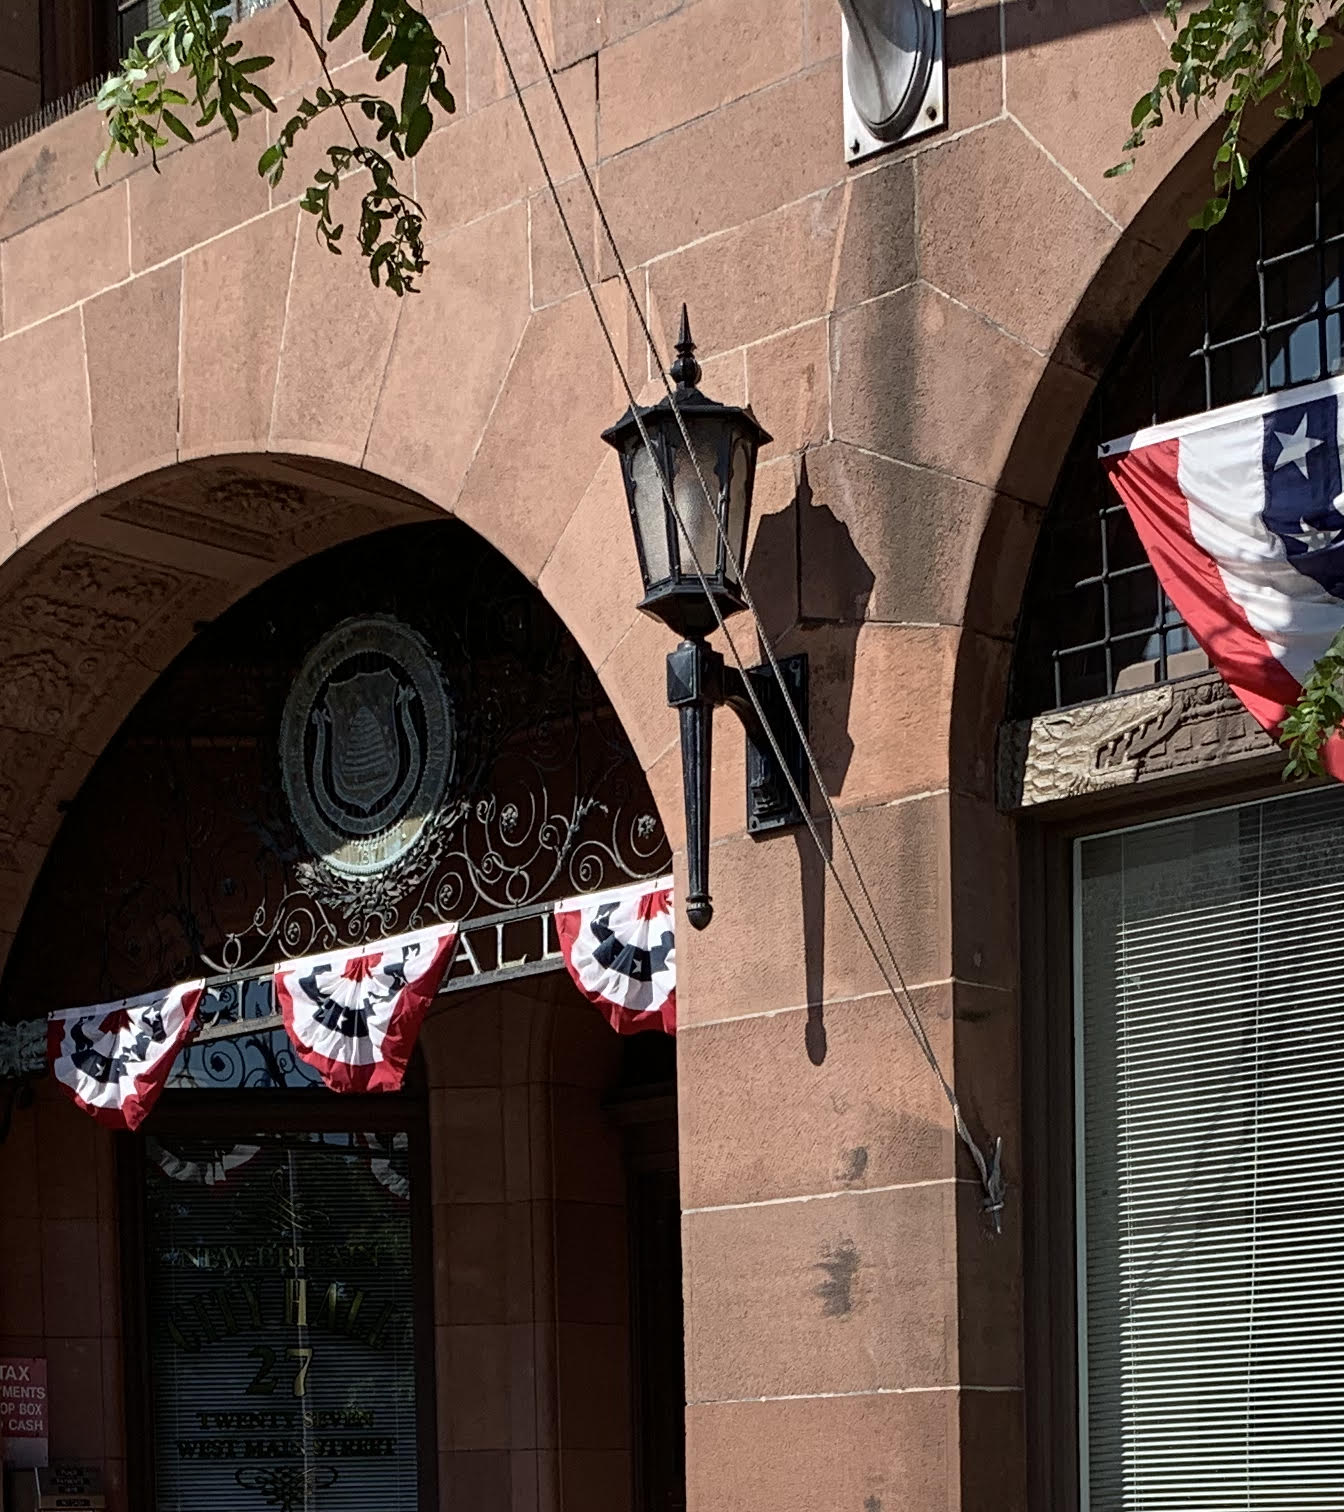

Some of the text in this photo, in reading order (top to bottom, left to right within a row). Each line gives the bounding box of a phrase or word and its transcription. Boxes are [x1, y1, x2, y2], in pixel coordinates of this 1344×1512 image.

[246, 1347, 313, 1397] 27
[0, 1385, 46, 1400] MENTS
[19, 1403, 42, 1416] BOX
[8, 1418, 44, 1431] CASH
